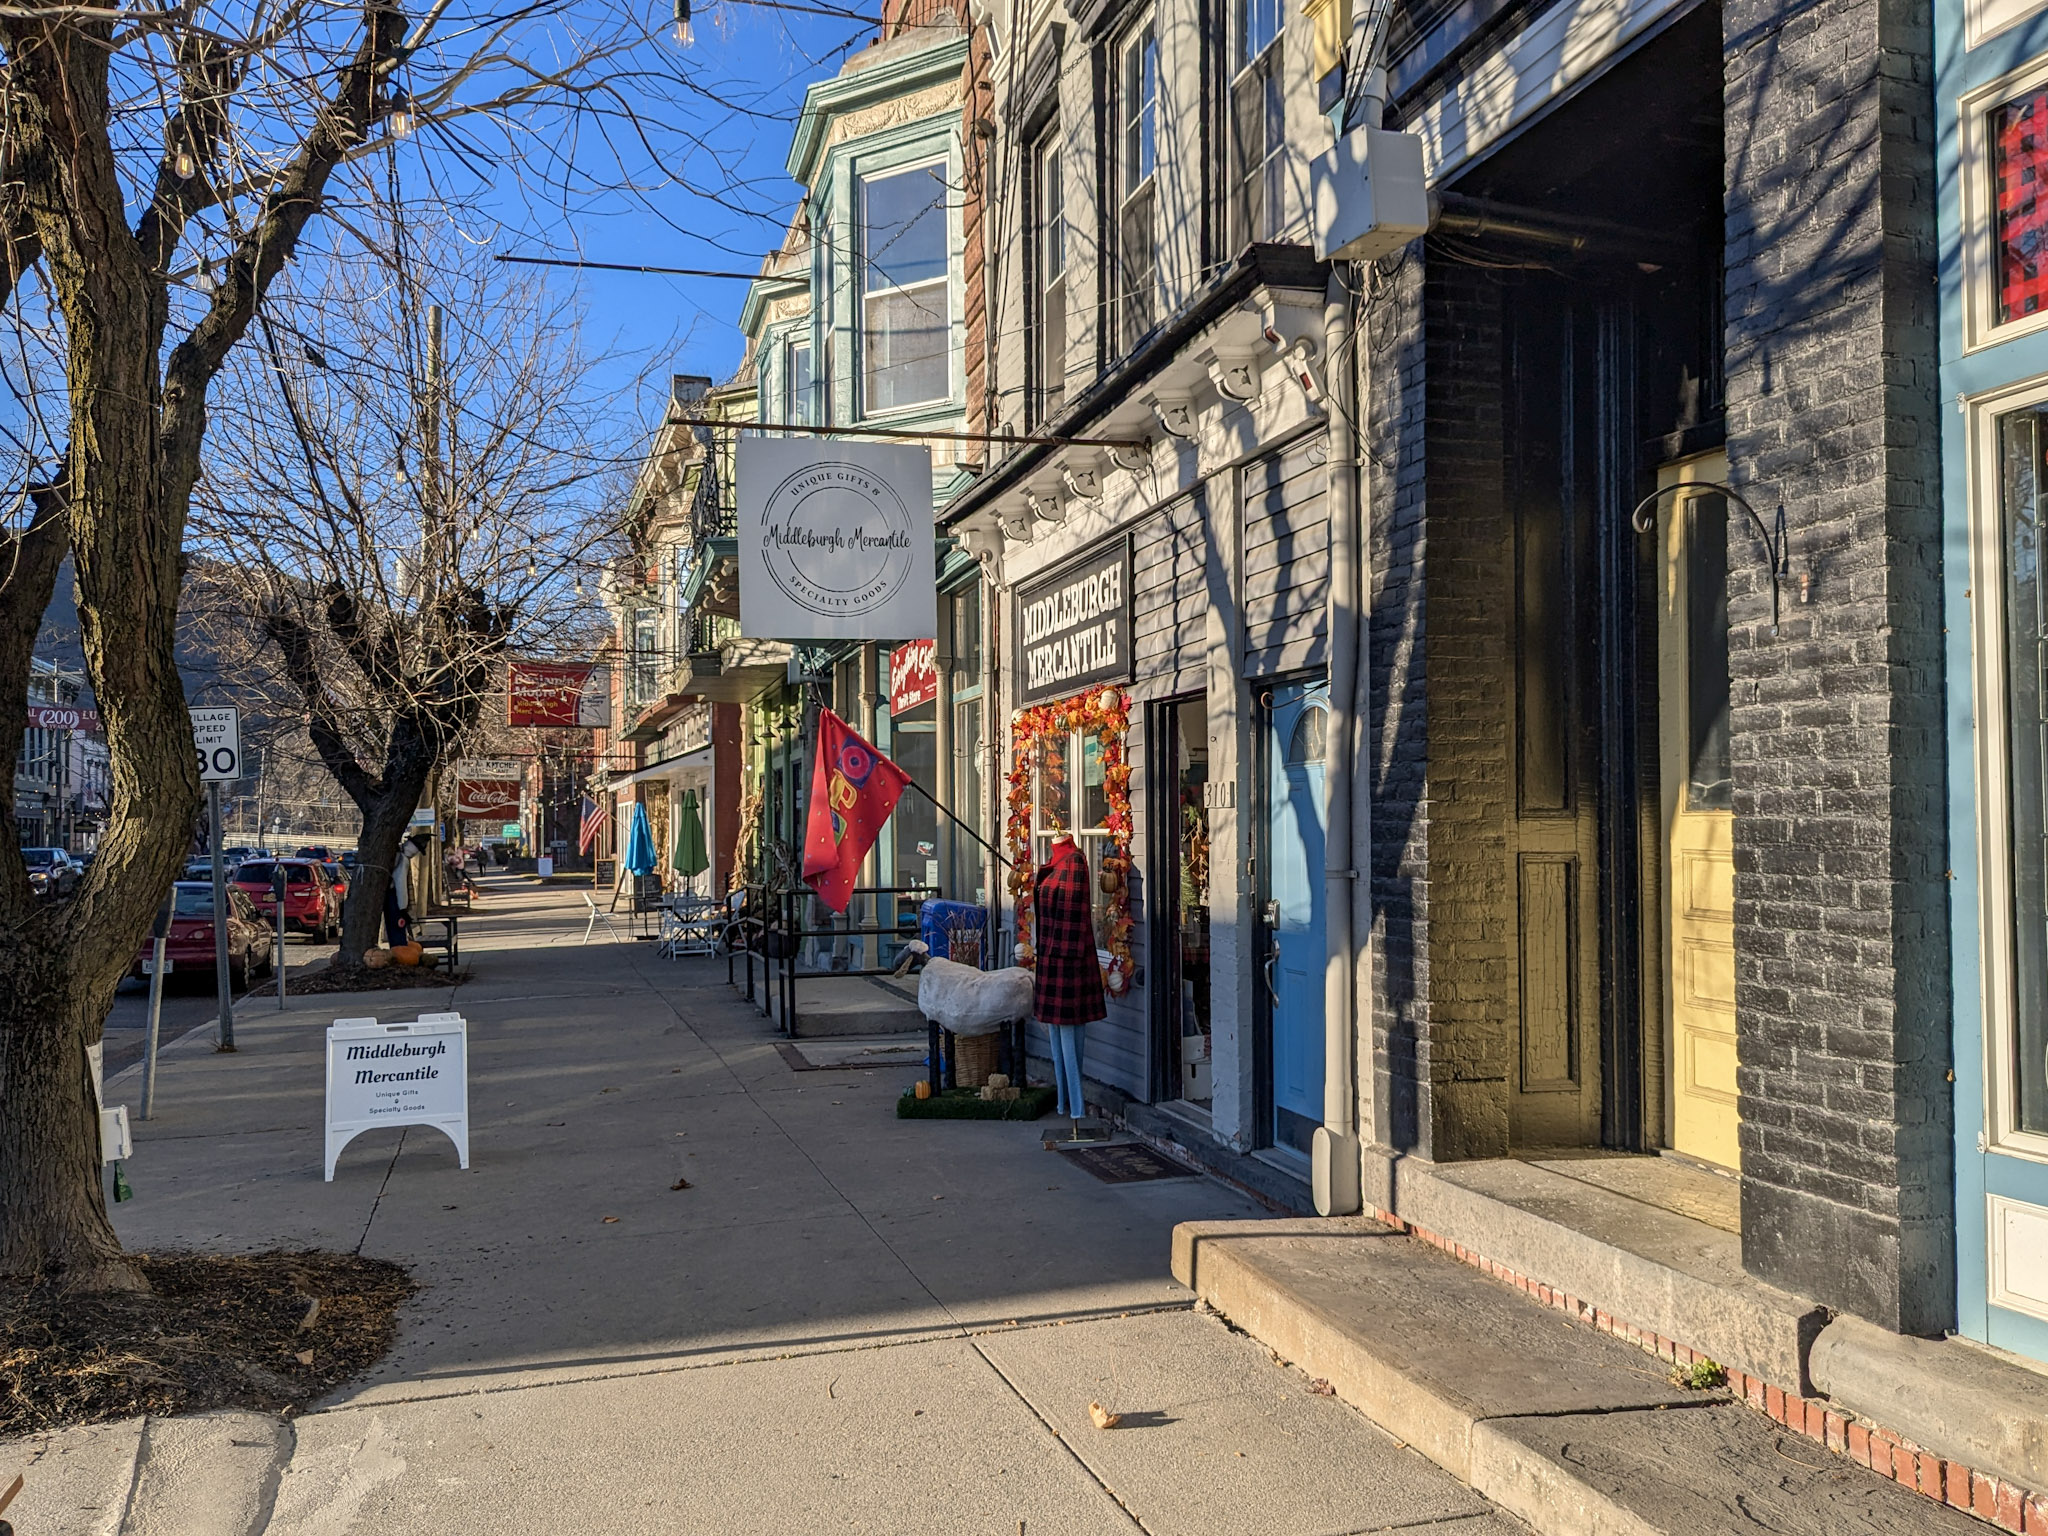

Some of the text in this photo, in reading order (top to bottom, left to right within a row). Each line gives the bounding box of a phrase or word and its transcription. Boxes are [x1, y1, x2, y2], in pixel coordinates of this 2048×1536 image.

[790, 472, 881, 496] UNIQUE GIFTS &
[763, 523, 912, 554] Middleburgh Mercantile
[789, 575, 888, 606] SPECIALTY GOODS
[1022, 561, 1123, 647] MIDDLEBURGH
[1027, 620, 1118, 691] MERCANTILE
[514, 686, 557, 697] Moore
[897, 690, 921, 710] Thrift Store
[46, 710, 73, 725] 200
[193, 725, 226, 733] SPEED
[196, 736, 223, 744] LIMIT
[1206, 782, 1226, 807] 310
[346, 1040, 446, 1060] Middleburgh
[354, 1065, 439, 1085] Mercantile
[369, 1106, 401, 1114] Specialty
